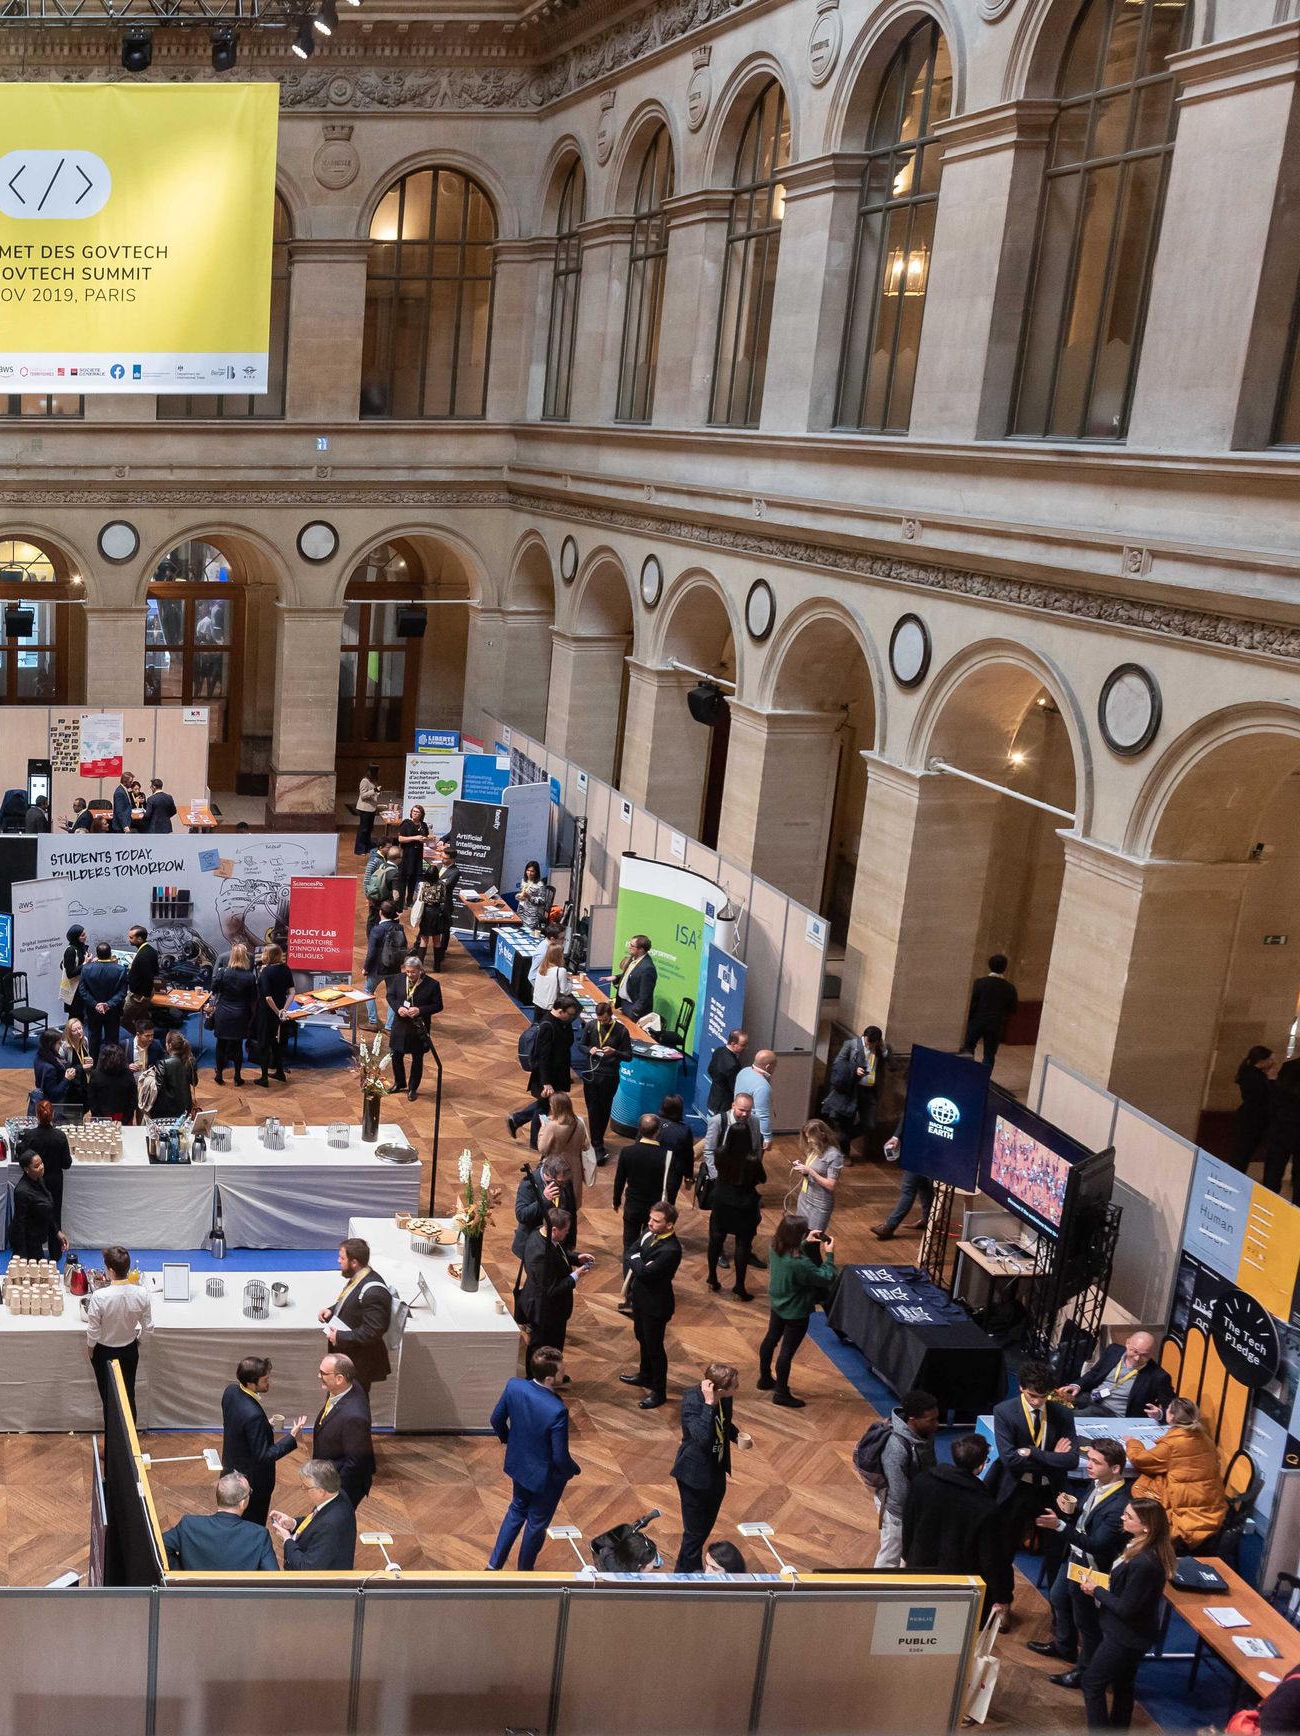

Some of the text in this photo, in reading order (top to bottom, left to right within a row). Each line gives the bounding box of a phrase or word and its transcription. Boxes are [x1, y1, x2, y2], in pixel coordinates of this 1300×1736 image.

[41, 245, 75, 259] DES
[82, 245, 168, 259] GOVTECH
[82, 266, 152, 281] SUMMIT
[32, 288, 78, 304] 2019,
[85, 288, 136, 302] PARIS
[493, 809, 502, 830] faculty
[456, 833, 483, 842] Artificial
[455, 841, 491, 851] Intelligence
[50, 849, 153, 866] STUDENTS TODAY.
[52, 860, 186, 882] ILDERS TOMORROW.
[18, 901, 34, 910] aws
[289, 938, 333, 946] LABORATOIRE
[289, 952, 324, 960] PUBLIQUES
[928, 1125, 954, 1141] EARTH
[929, 1121, 954, 1133] HACK FOR
[1200, 1204, 1234, 1234] Human
[1223, 1316, 1267, 1356] The Tech
[1225, 1332, 1260, 1366] Pledge
[898, 1637, 937, 1645] PUBLIC
